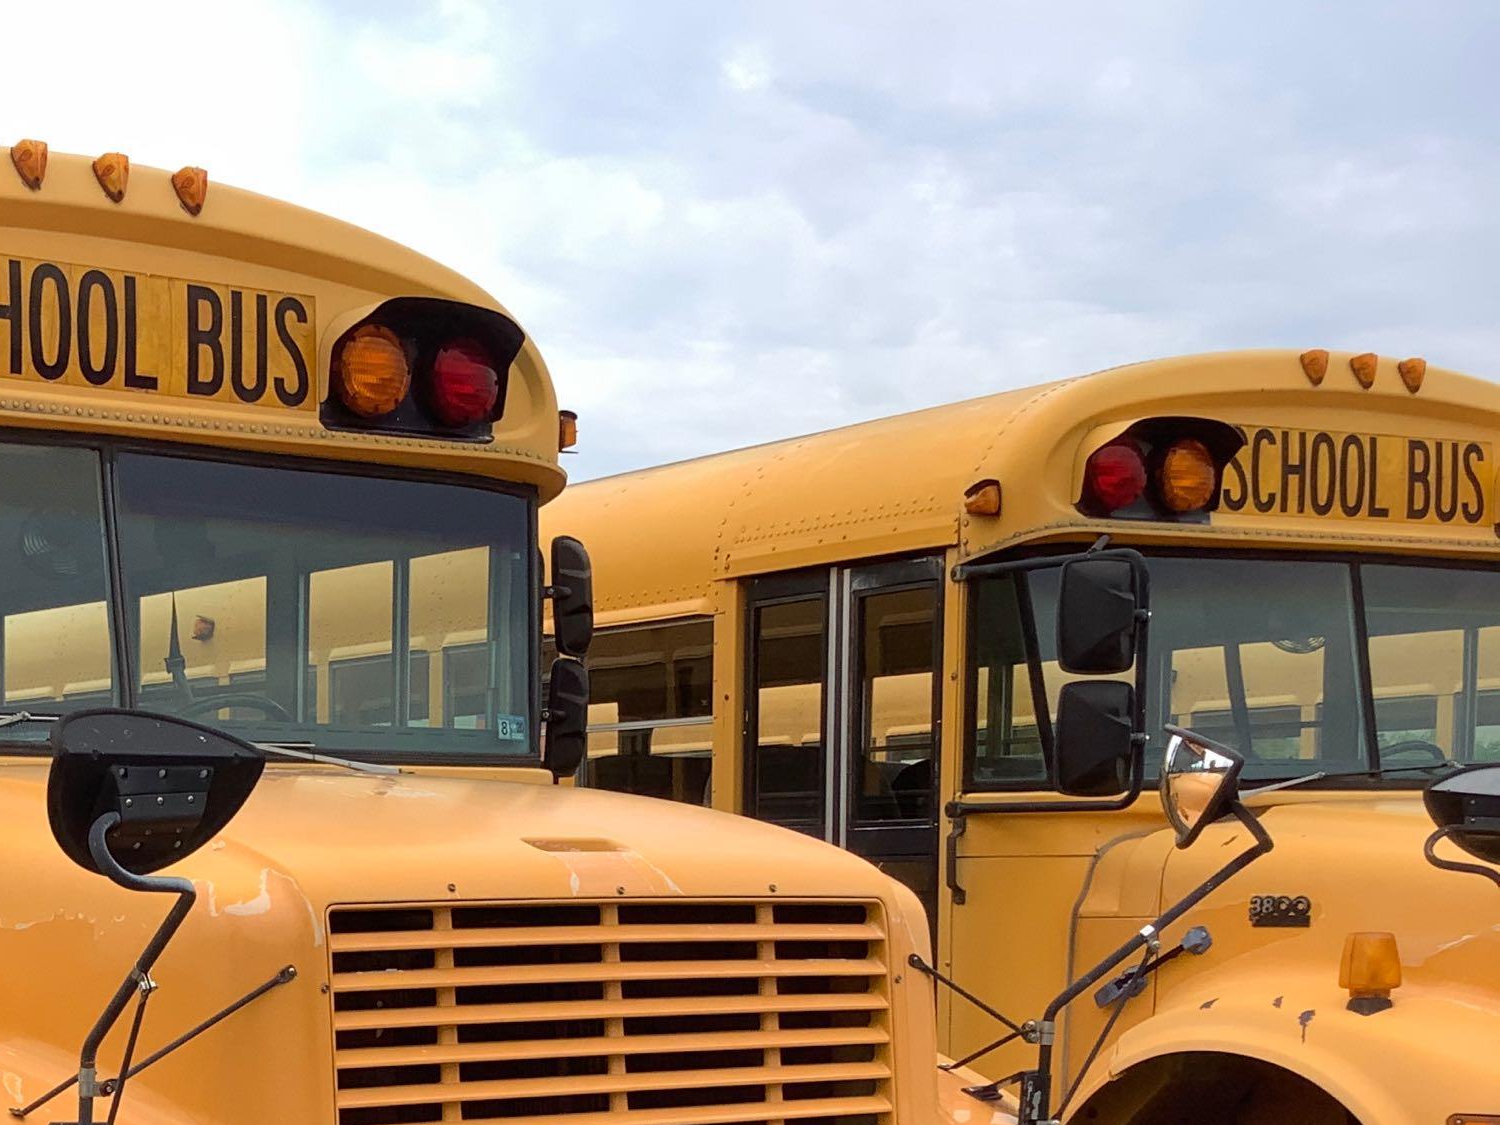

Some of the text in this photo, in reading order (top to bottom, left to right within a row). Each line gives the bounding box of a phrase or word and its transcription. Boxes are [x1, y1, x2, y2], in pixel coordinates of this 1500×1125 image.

[186, 283, 310, 408] BUS
[1222, 425, 1485, 523] SCHOOL BUS
